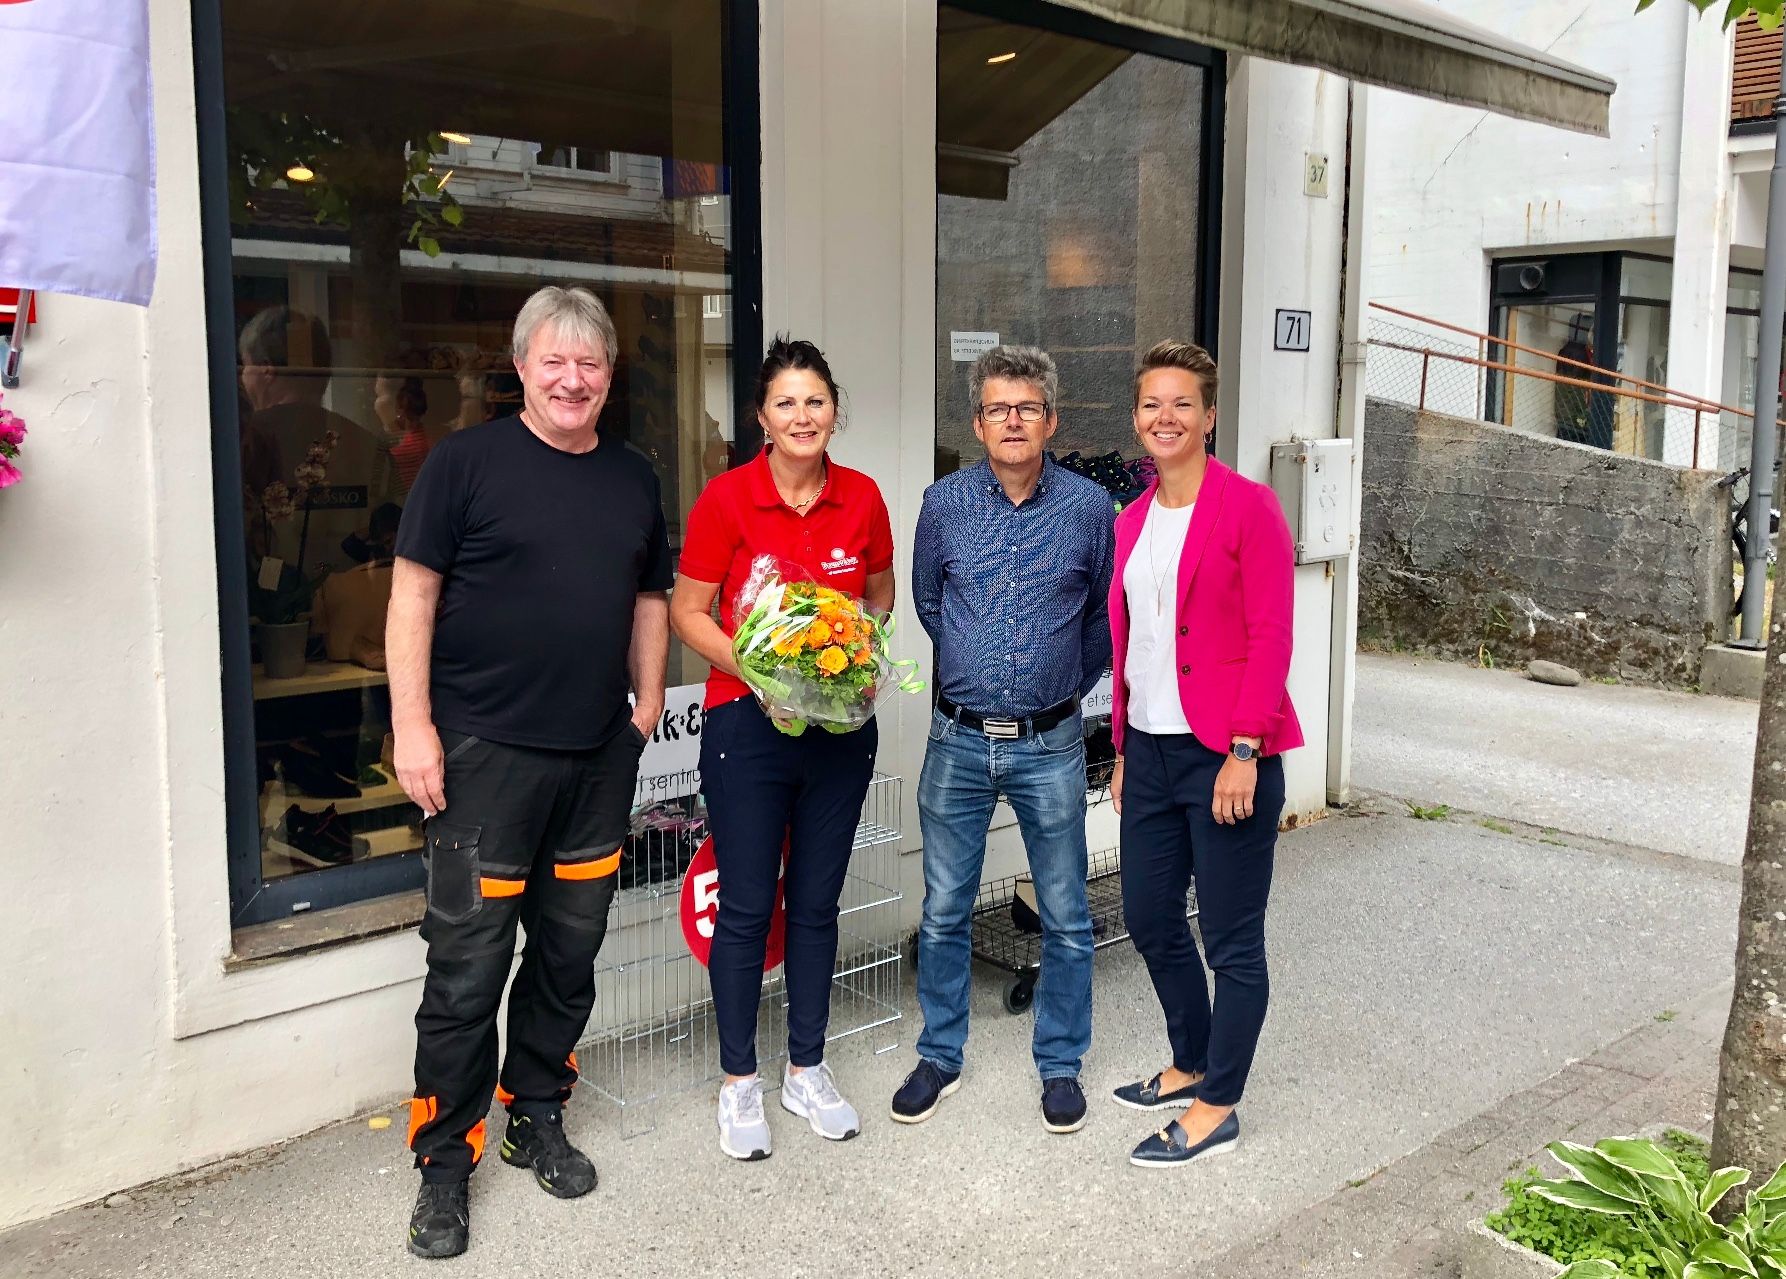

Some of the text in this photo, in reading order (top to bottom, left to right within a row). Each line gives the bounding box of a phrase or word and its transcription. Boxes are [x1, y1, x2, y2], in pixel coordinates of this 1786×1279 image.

[1310, 164, 1325, 183] 37
[1285, 316, 1302, 345] 71
[1087, 693, 1113, 708] et se
[649, 768, 702, 791] sentru
[693, 868, 720, 938] 5
